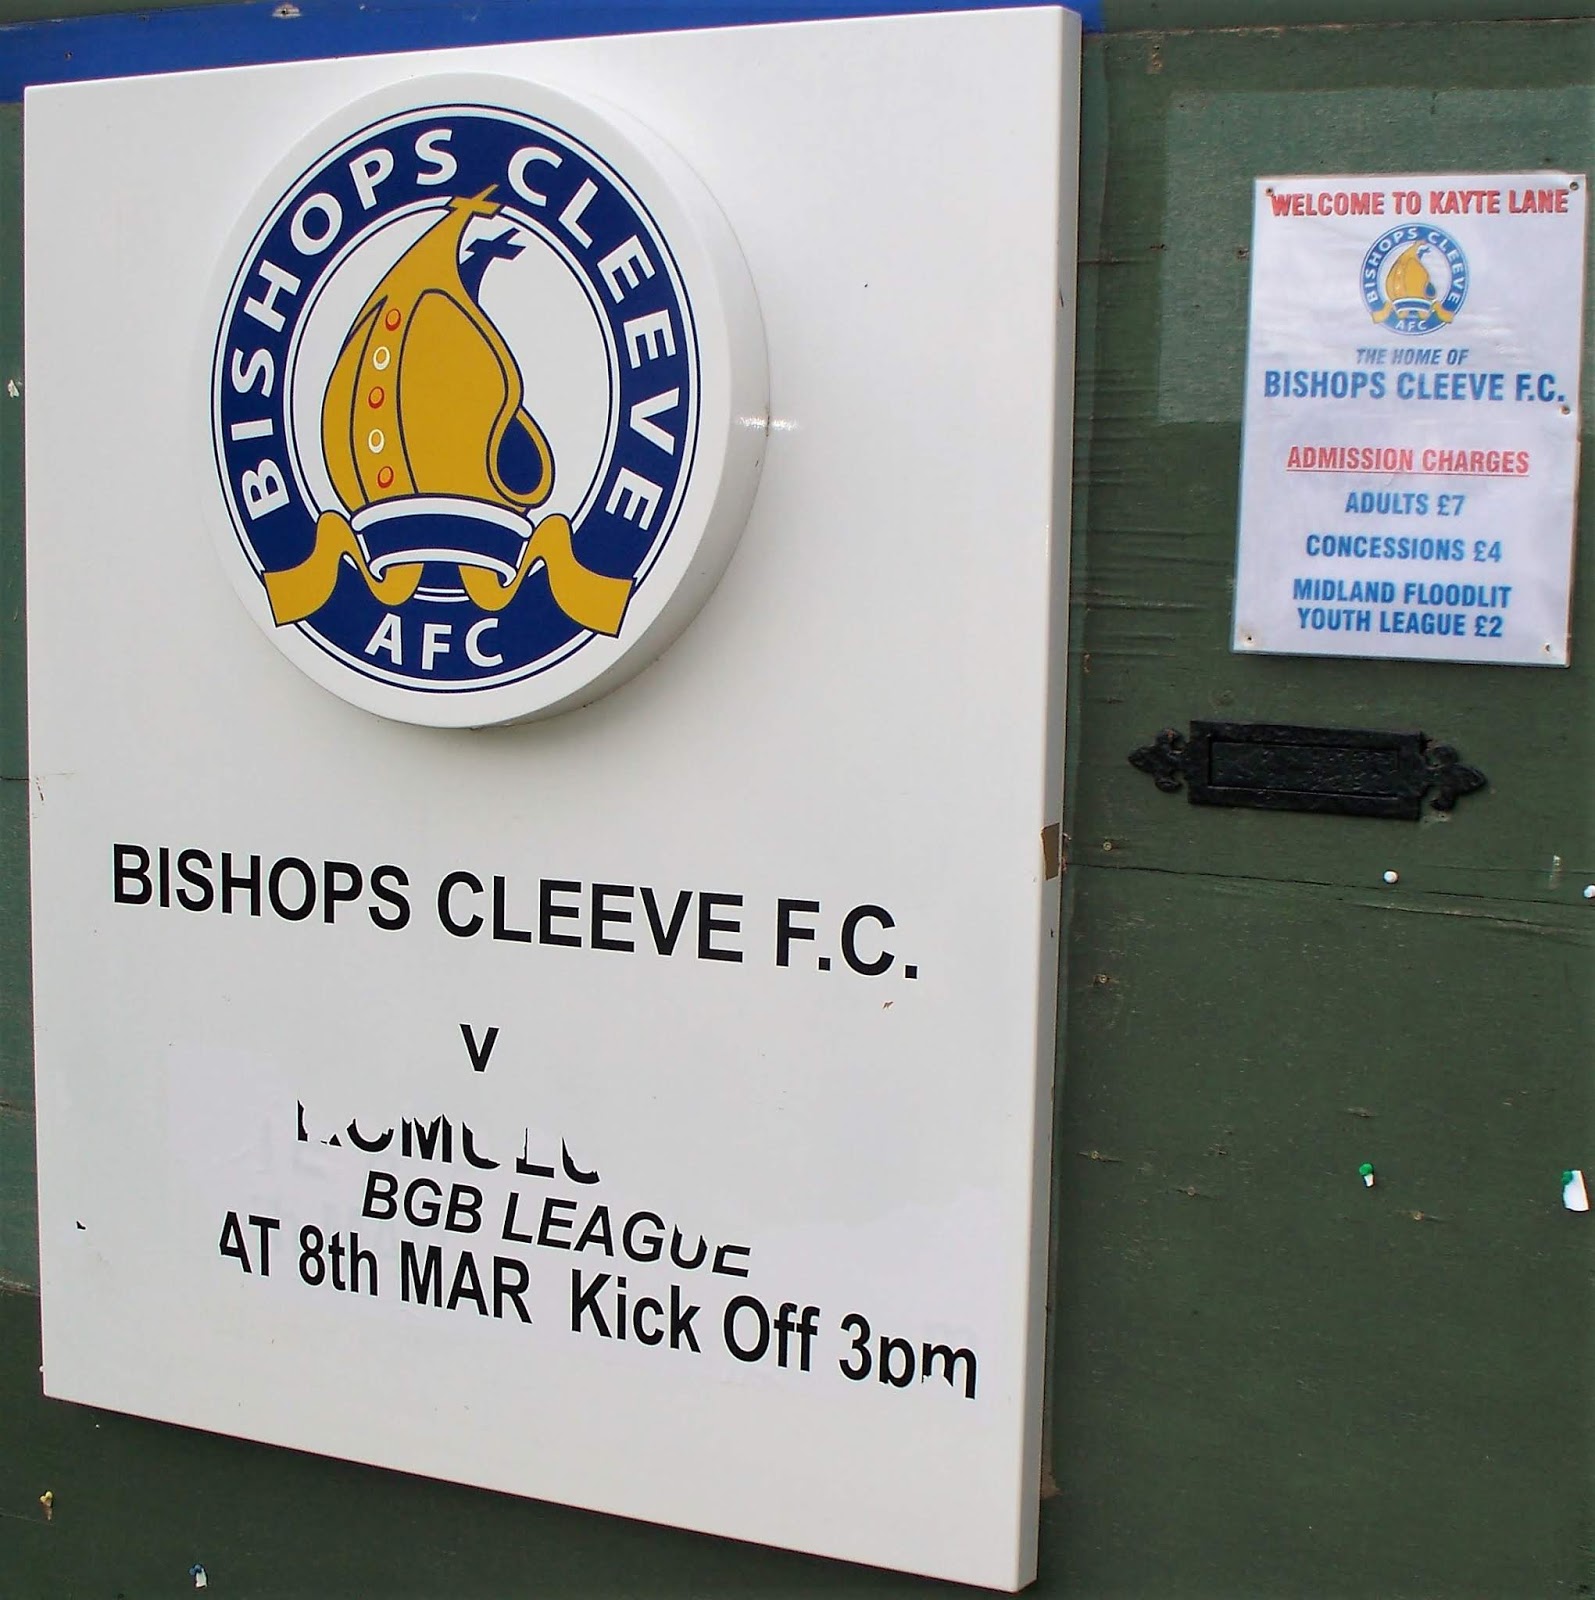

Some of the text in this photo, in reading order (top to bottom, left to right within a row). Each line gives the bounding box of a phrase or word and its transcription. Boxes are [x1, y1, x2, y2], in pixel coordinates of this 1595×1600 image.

[1271, 188, 1569, 216] WELCOME TO KAYTE LANE
[1364, 227, 1466, 305] BISHOPS CLEEVE
[231, 128, 680, 531] BISHOPS CLEEVE
[1395, 320, 1427, 332] AFC
[1356, 349, 1469, 366] THE HOME OF
[1264, 370, 1566, 402] BISHOPS CLEEVE F.C.
[1287, 446, 1530, 474] ADMISSION CHARGES
[1345, 491, 1465, 516] ADULTS £7
[1306, 534, 1501, 563] CONCESSIONS £4
[1293, 578, 1512, 609] MIDLAND FLOODLIT
[1297, 607, 1503, 638] YOUTH LEAGUE £2
[365, 611, 504, 671] AFC
[114, 843, 918, 980] BISHOPS CLEEVE F.C.
[362, 1171, 751, 1278] BGB LEAGUE
[298, 1224, 378, 1297] 8th
[400, 1241, 532, 1324] MAR
[572, 1268, 700, 1354] Kick
[724, 1295, 821, 1372] Off
